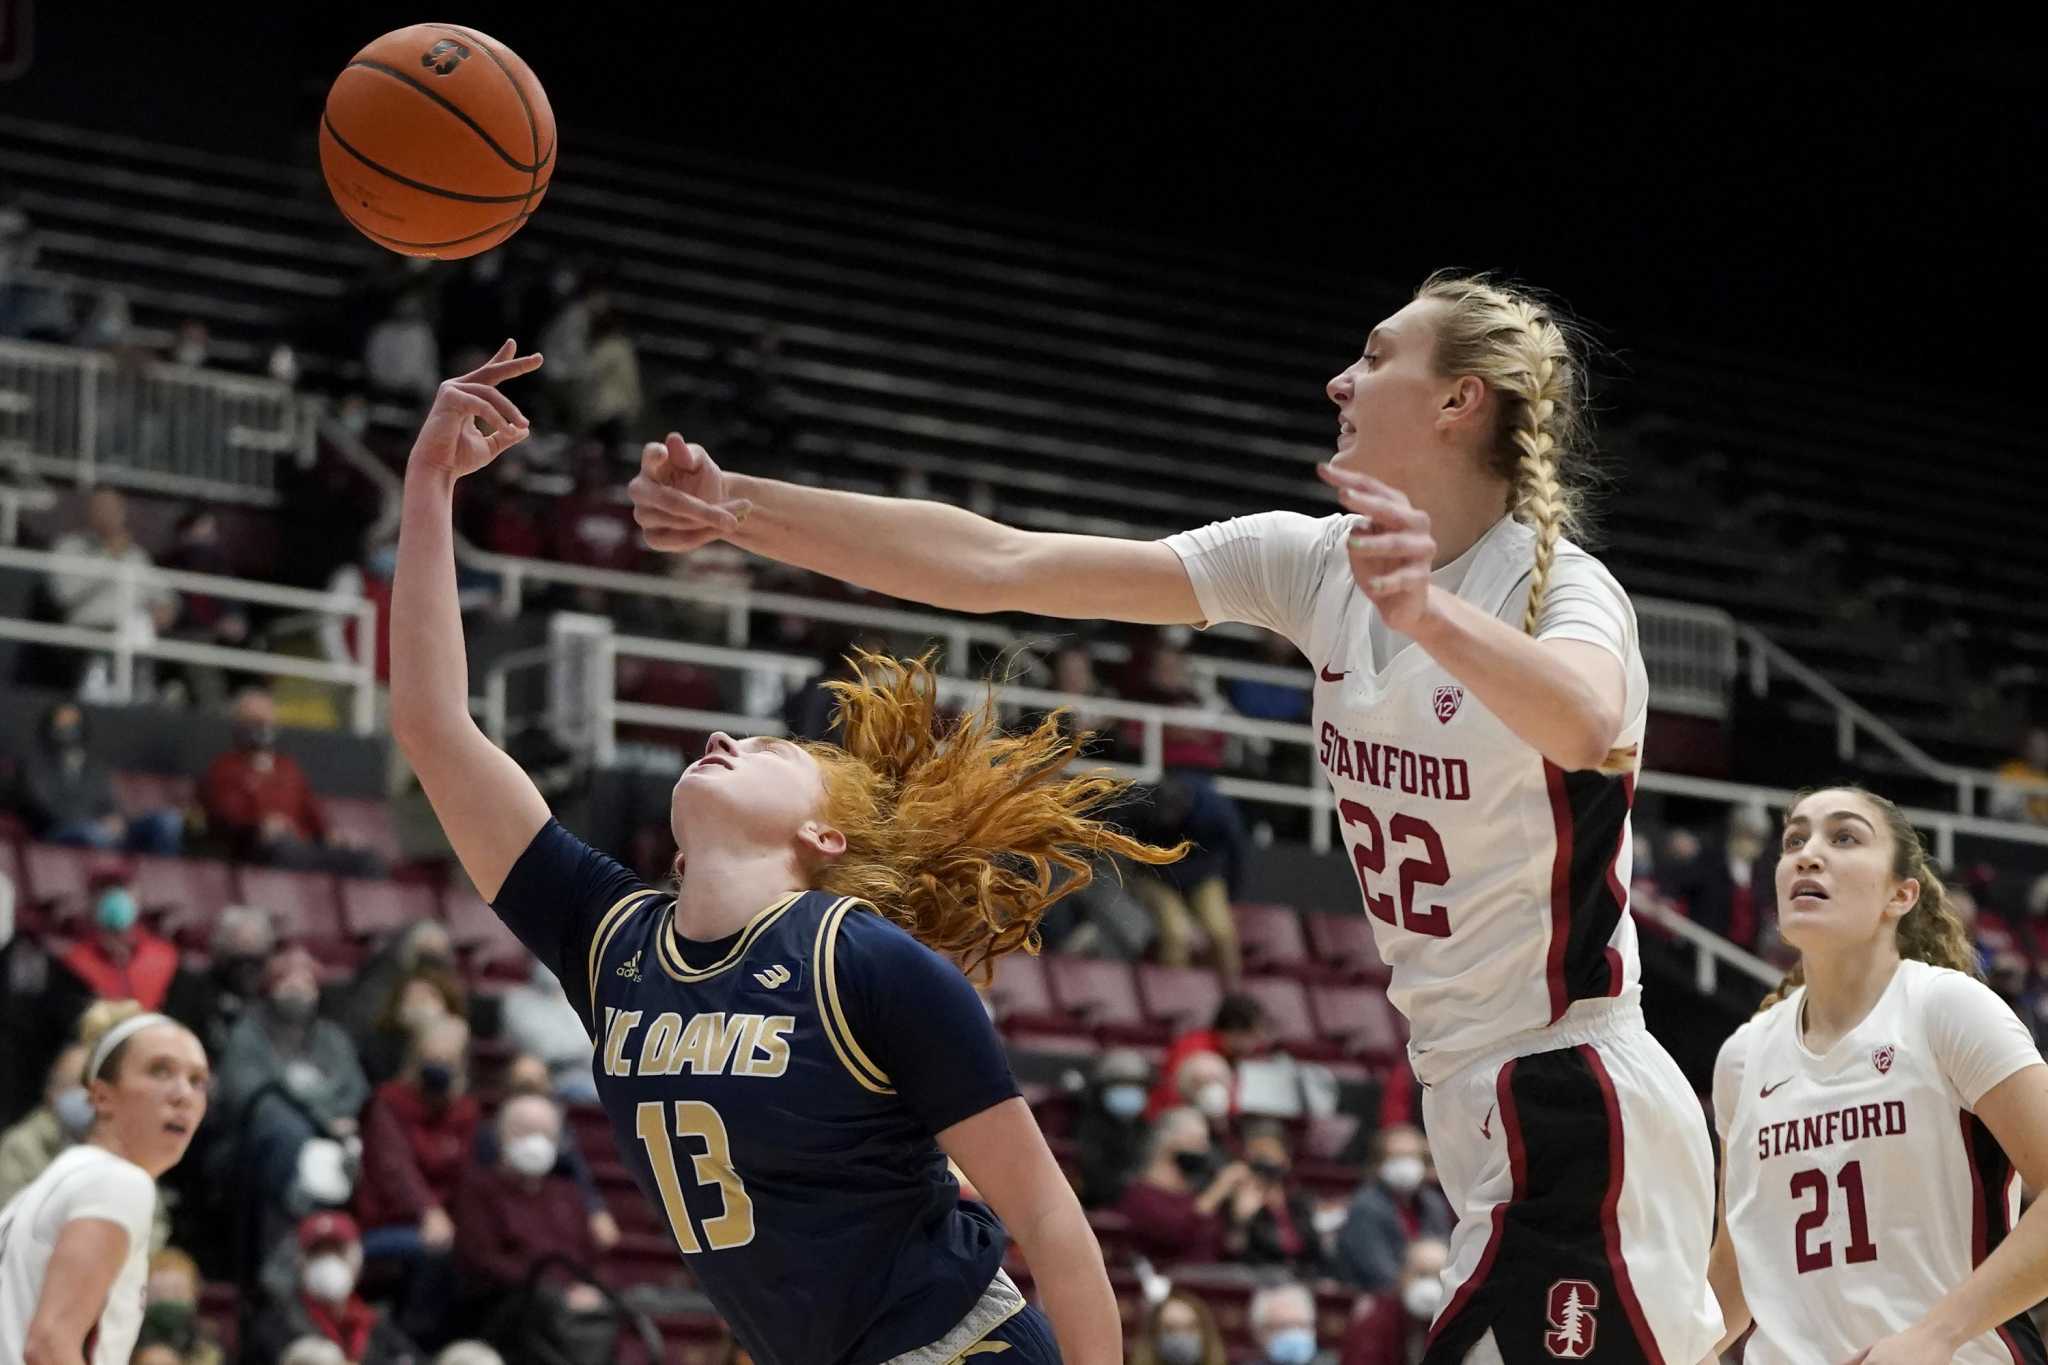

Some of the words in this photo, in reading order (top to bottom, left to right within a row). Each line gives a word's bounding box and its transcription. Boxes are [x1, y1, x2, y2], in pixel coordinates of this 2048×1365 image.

[1339, 798, 1453, 938] 22
[637, 1012, 796, 1077] DAVIS
[636, 1101, 756, 1253] 13
[1758, 1100, 1907, 1161] STANFORD
[1790, 1160, 1878, 1275] 21
